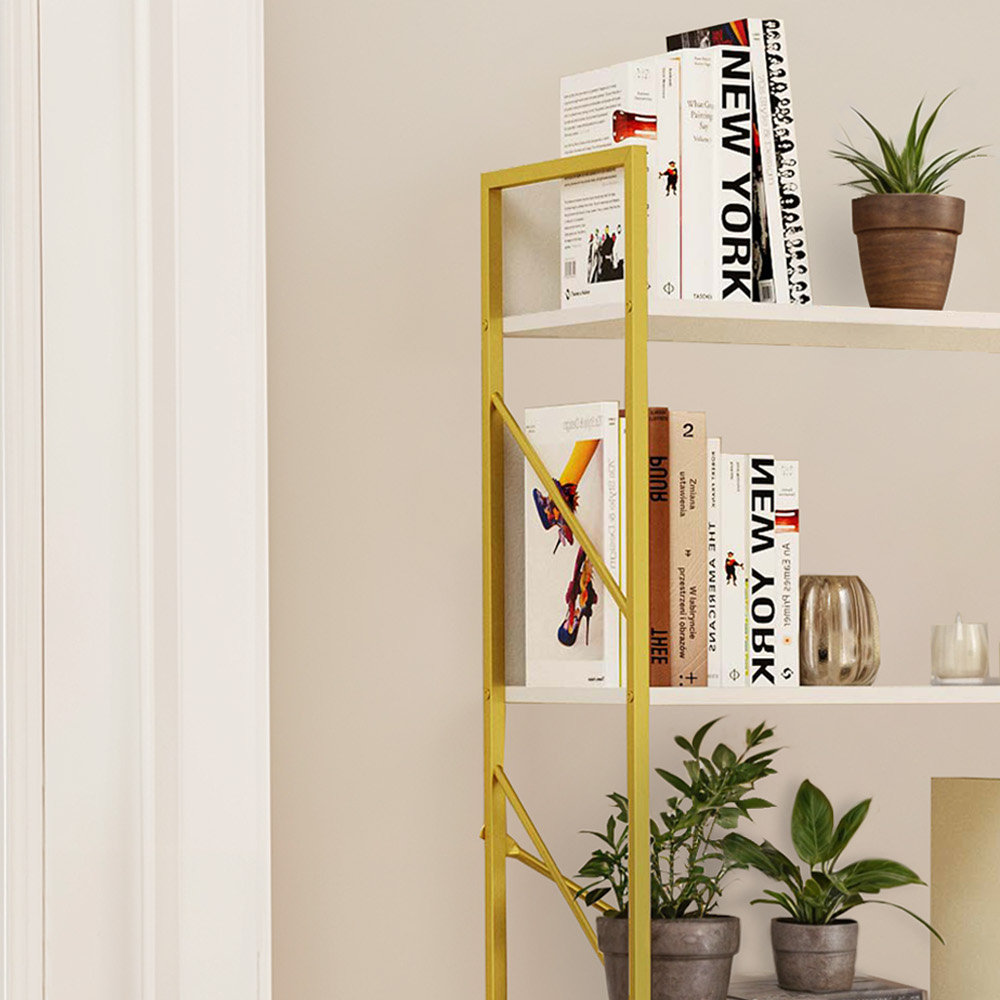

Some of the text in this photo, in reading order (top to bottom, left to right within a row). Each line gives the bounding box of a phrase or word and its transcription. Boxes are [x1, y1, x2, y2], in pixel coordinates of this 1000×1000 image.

[721, 49, 751, 300] NEW YORK
[682, 423, 694, 437] 2
[689, 478, 697, 510] Zmiana
